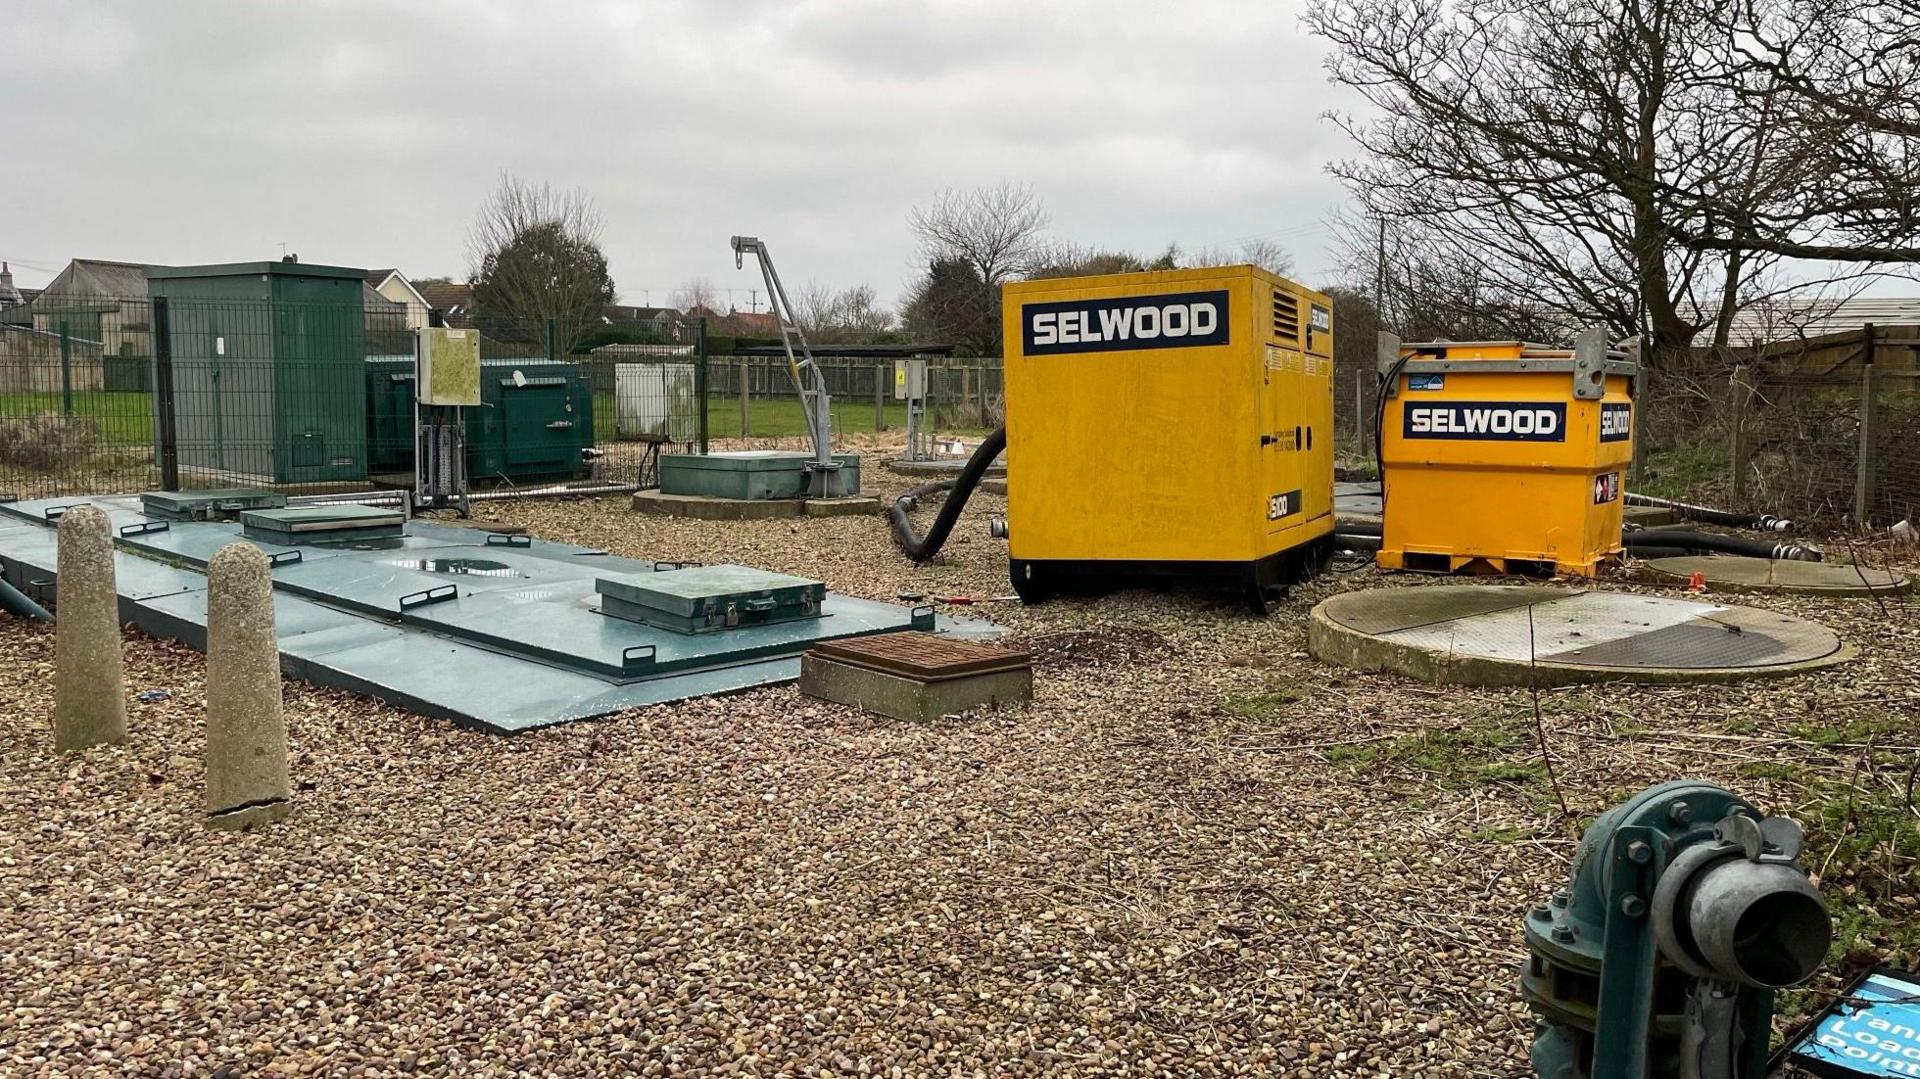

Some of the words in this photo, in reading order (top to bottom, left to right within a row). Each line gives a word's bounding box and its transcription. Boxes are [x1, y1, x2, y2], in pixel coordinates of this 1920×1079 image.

[1033, 302, 1217, 345] SELWOOD
[1412, 408, 1557, 435] SELWOOD
[1602, 410, 1629, 435] SELWOOD
